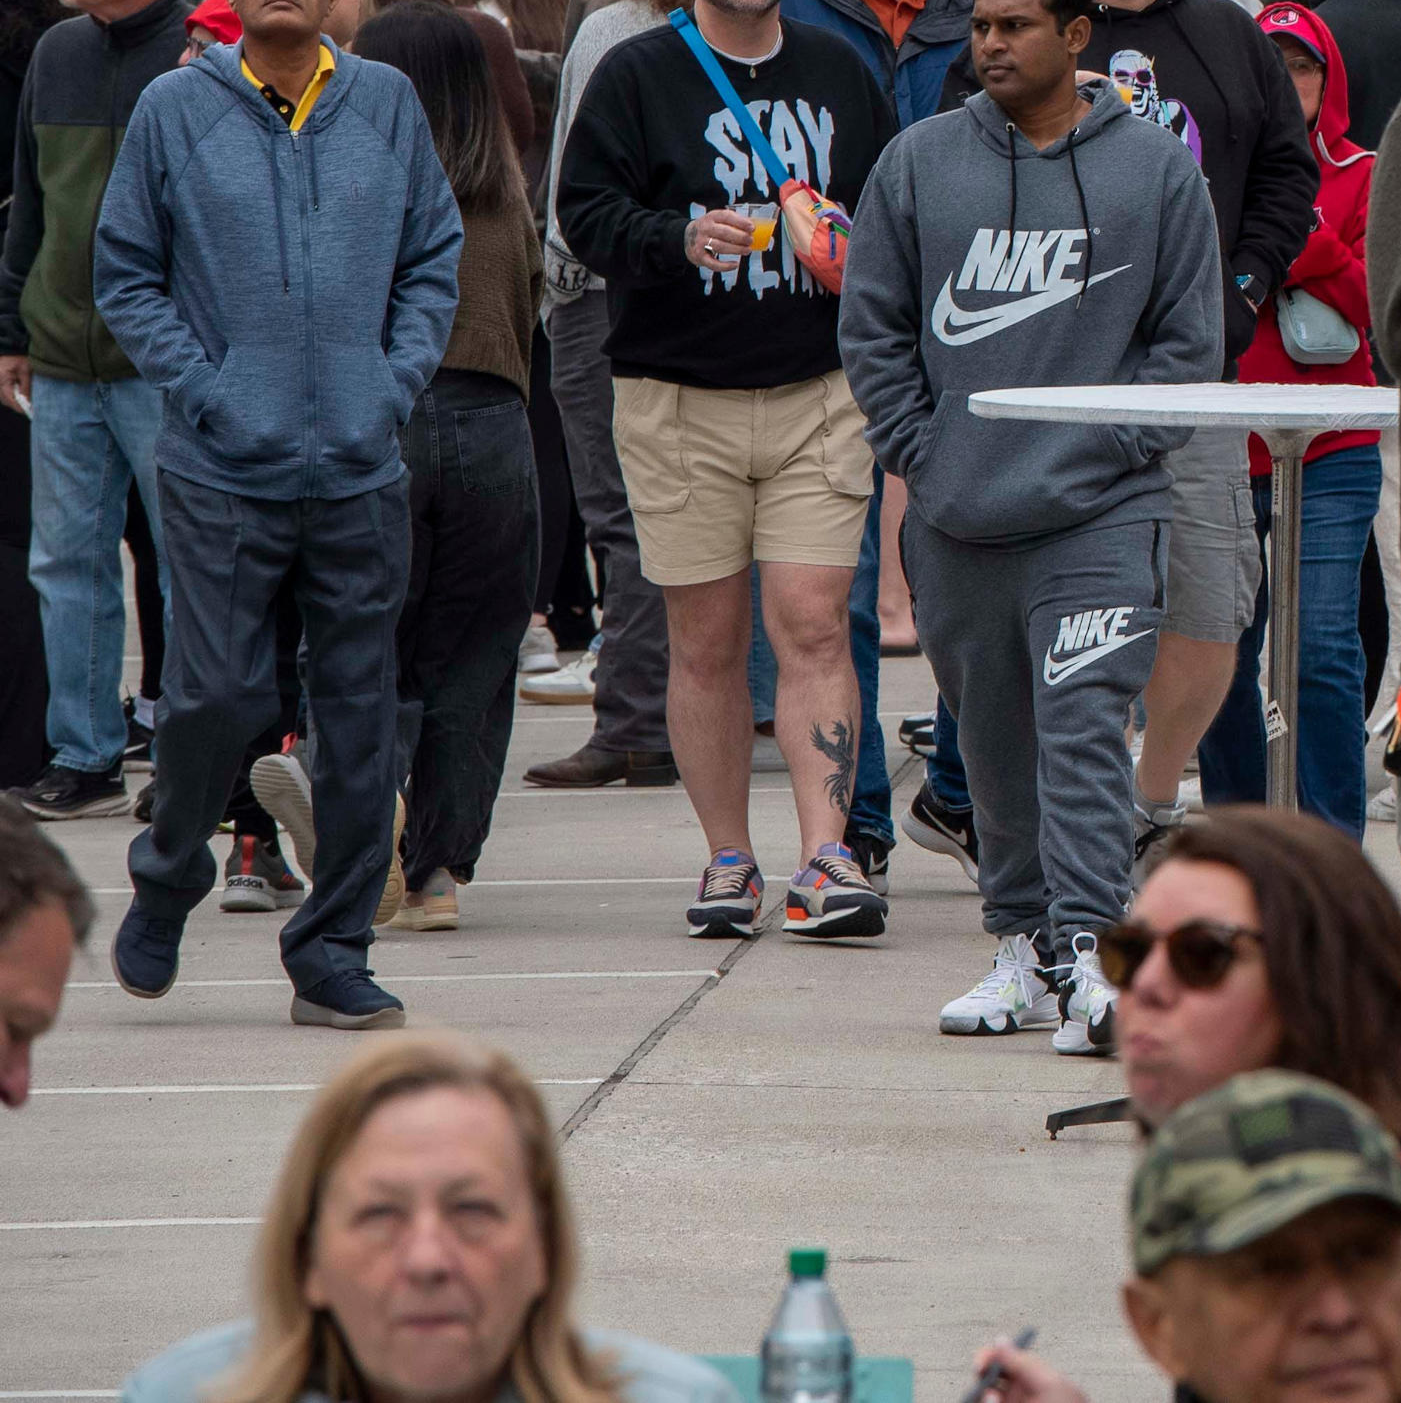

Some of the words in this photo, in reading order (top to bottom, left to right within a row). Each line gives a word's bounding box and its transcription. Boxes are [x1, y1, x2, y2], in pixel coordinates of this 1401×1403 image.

[703, 98, 835, 206] STAY
[956, 228, 1088, 293] NIKE
[1053, 605, 1135, 655] NIKE
